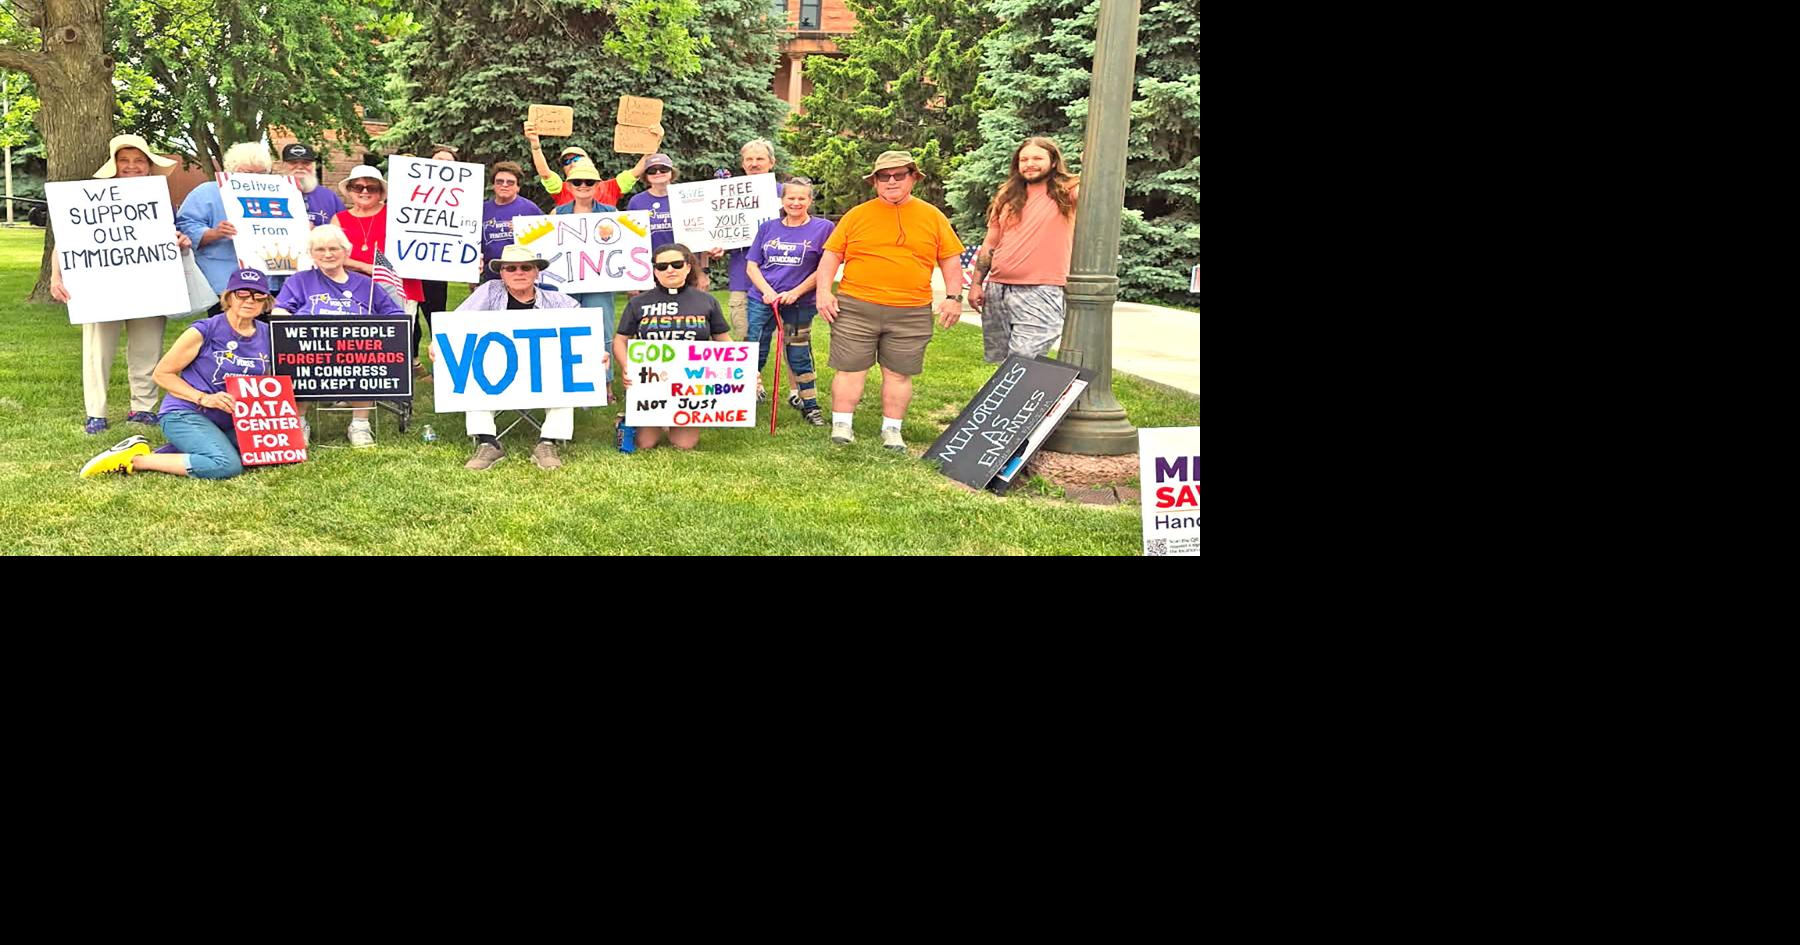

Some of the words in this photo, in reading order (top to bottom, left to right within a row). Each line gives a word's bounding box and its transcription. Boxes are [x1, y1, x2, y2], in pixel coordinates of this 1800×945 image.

[408, 163, 472, 182] STOP
[83, 186, 122, 201] WE
[231, 180, 280, 192] Deliver
[720, 181, 753, 196] FREE
[410, 185, 464, 207] HIS
[711, 195, 760, 211] SPEACH
[69, 201, 159, 225] SUPPORT
[715, 212, 746, 229] YOUR
[93, 225, 137, 243] OUR
[252, 224, 289, 236] From
[558, 217, 621, 246] NO
[709, 227, 750, 240] VOICE
[62, 242, 178, 270] IMMIGRANTS
[265, 257, 298, 271] EVIL
[536, 246, 651, 284] KINGS
[641, 302, 679, 316] THIS
[640, 315, 706, 331] PASTOR
[285, 327, 308, 338] WE
[311, 327, 339, 338] THE
[342, 326, 396, 338] PEOPLE
[639, 330, 697, 341] OVES
[299, 340, 334, 352] WILL
[336, 339, 383, 351] NEVER
[628, 341, 675, 363] GOD
[688, 345, 749, 362] LOVES
[278, 353, 332, 365] FORGET
[336, 352, 404, 364] COWARDS
[435, 326, 595, 395] VOTE
[296, 365, 311, 377] IN
[314, 365, 388, 377] CONGRESS
[638, 366, 669, 384] the
[239, 378, 282, 399] NO
[321, 379, 357, 390] KEPT
[359, 378, 400, 390] QUIET
[671, 382, 745, 397] RAINBOW
[234, 400, 296, 419] DATA
[637, 400, 668, 412] NOT
[939, 362, 1027, 463] MINORITIES
[236, 417, 299, 432] CENTER
[673, 410, 748, 426] ORANGE
[977, 389, 1046, 468] ENEMIES
[981, 414, 1010, 445] AS
[253, 433, 290, 449] FOR
[242, 448, 307, 466] CLINTON
[1155, 485, 1200, 508] SA
[1155, 515, 1200, 530] Han
